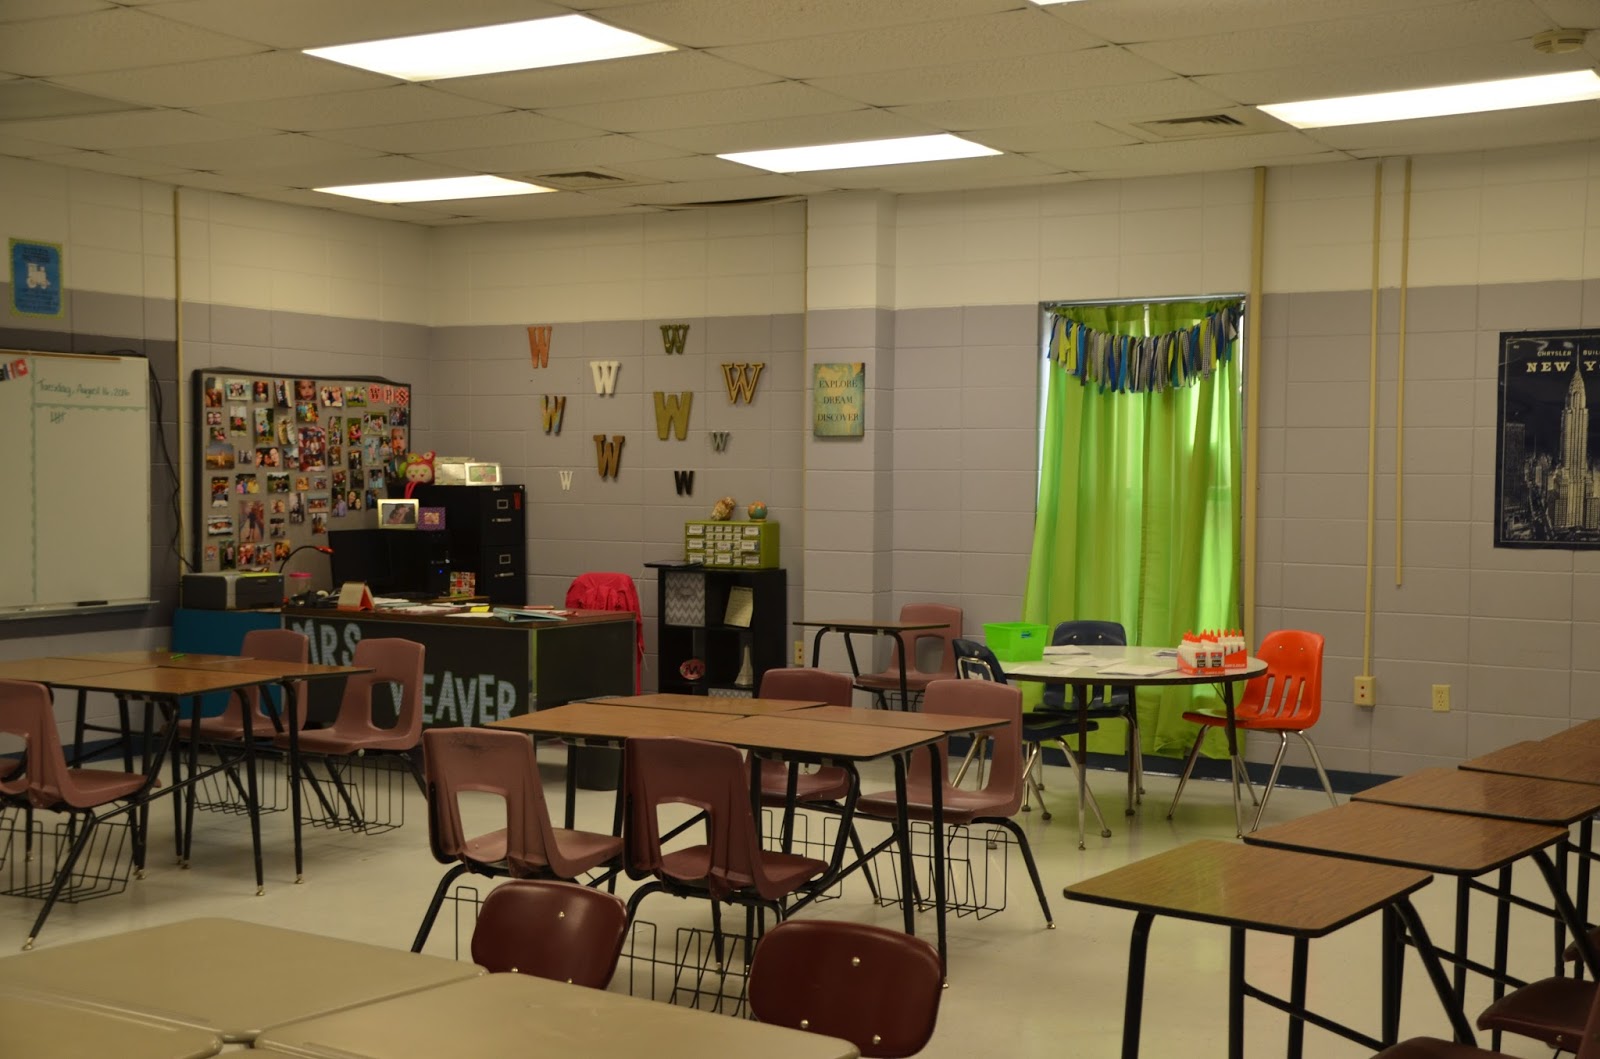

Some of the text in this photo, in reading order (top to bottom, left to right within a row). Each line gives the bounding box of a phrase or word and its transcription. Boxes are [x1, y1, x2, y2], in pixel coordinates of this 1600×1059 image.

[528, 326, 552, 368] W
[660, 324, 690, 355] W
[590, 360, 621, 394] W
[1526, 360, 1600, 373] NEW Y
[721, 363, 765, 404] W
[819, 380, 857, 388] EXPLORE
[540, 394, 566, 434] W
[823, 396, 853, 404] DREAM
[653, 391, 693, 441] W
[817, 413, 859, 422] DISCOVER
[593, 434, 625, 478] W
[709, 431, 729, 451] W
[559, 470, 574, 491] W
[674, 470, 695, 495] W
[293, 619, 361, 667] MRS
